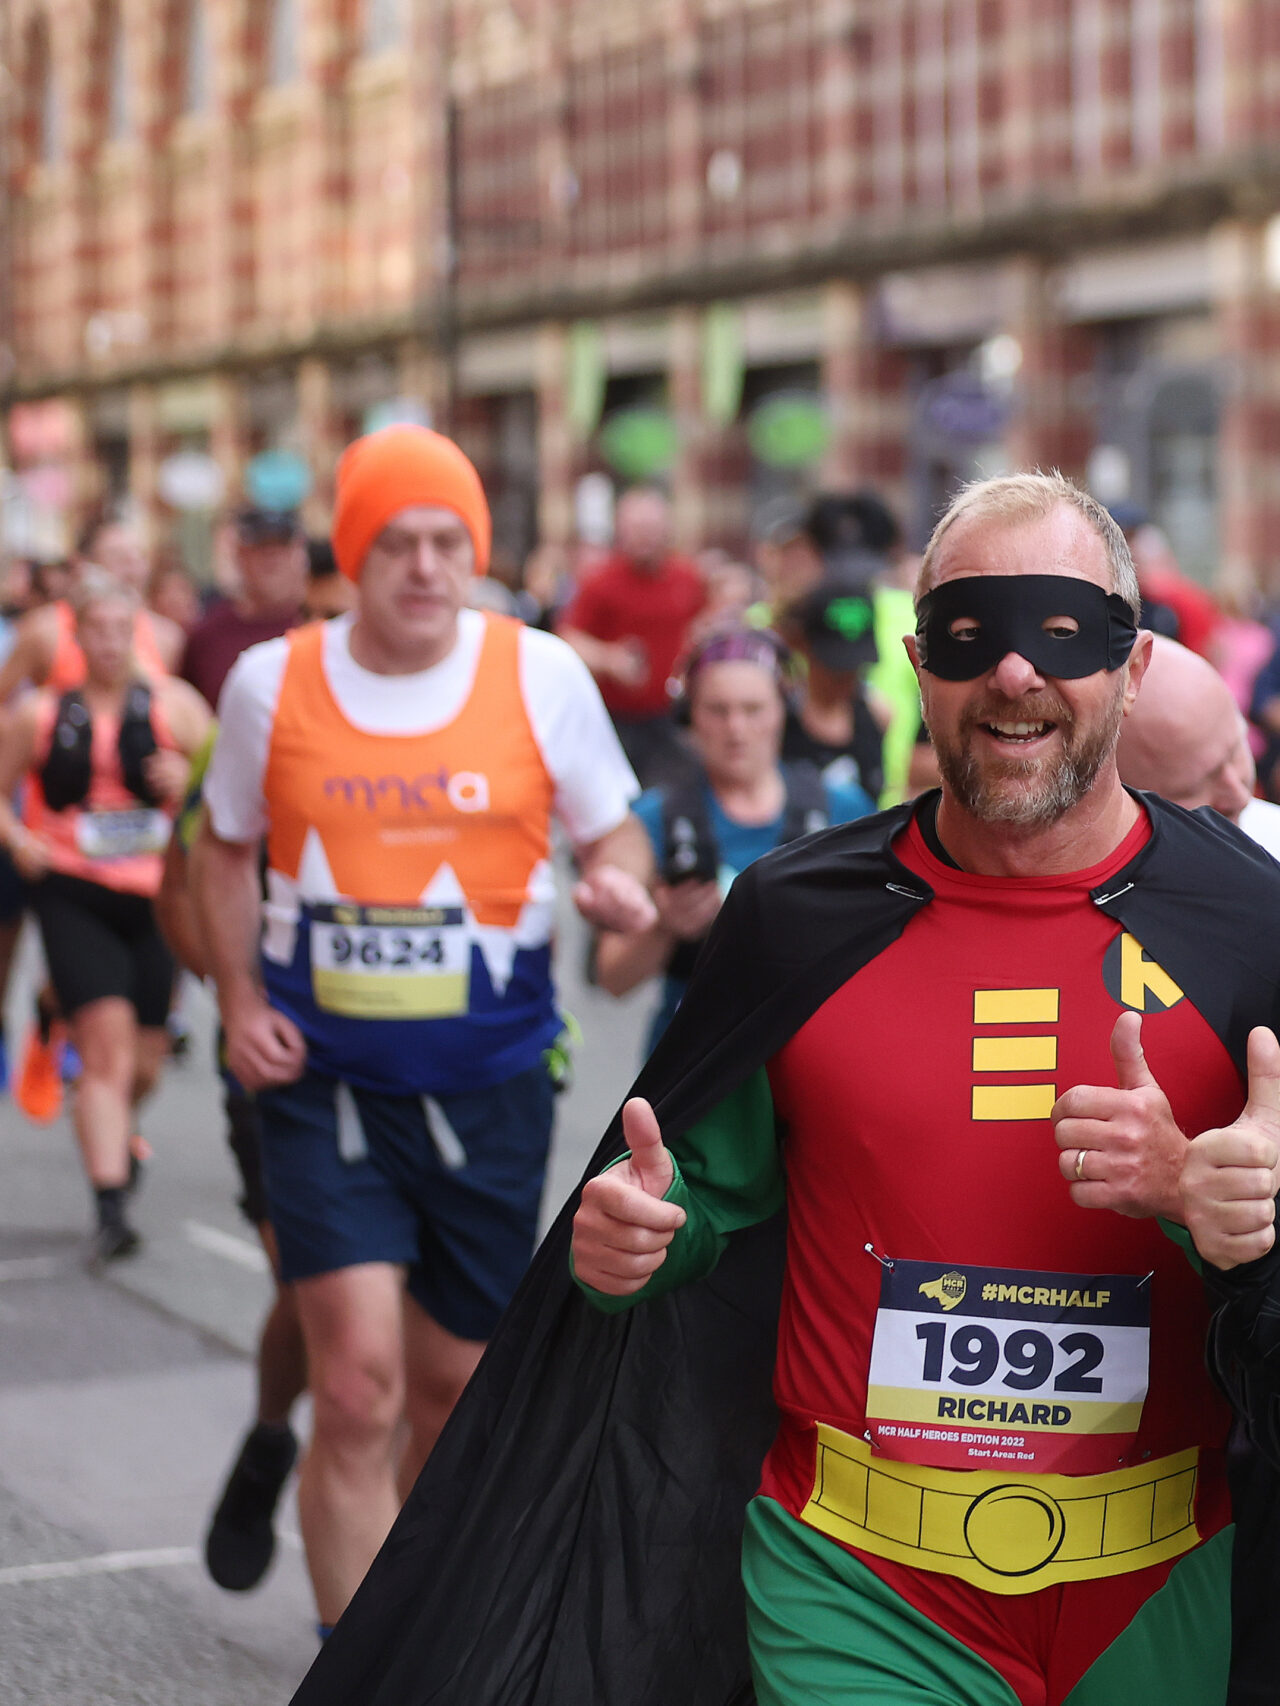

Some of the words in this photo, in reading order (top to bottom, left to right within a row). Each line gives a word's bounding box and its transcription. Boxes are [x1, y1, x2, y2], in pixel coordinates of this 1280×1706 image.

[330, 929, 445, 967] 9624
[943, 1279, 963, 1288] MCR
[981, 1283, 1111, 1308] #MCRHALF
[915, 1322, 1105, 1393] 1992
[937, 1397, 1072, 1425] RICHARD
[878, 1425, 896, 1436] MCR
[897, 1426, 922, 1438] HALF
[922, 1429, 959, 1442] HEROES
[961, 1433, 1000, 1445] EDITION
[1001, 1436, 1025, 1447] 2022
[968, 1448, 991, 1457] Start
[992, 1450, 1016, 1459] Area:
[1017, 1451, 1035, 1460] Red
